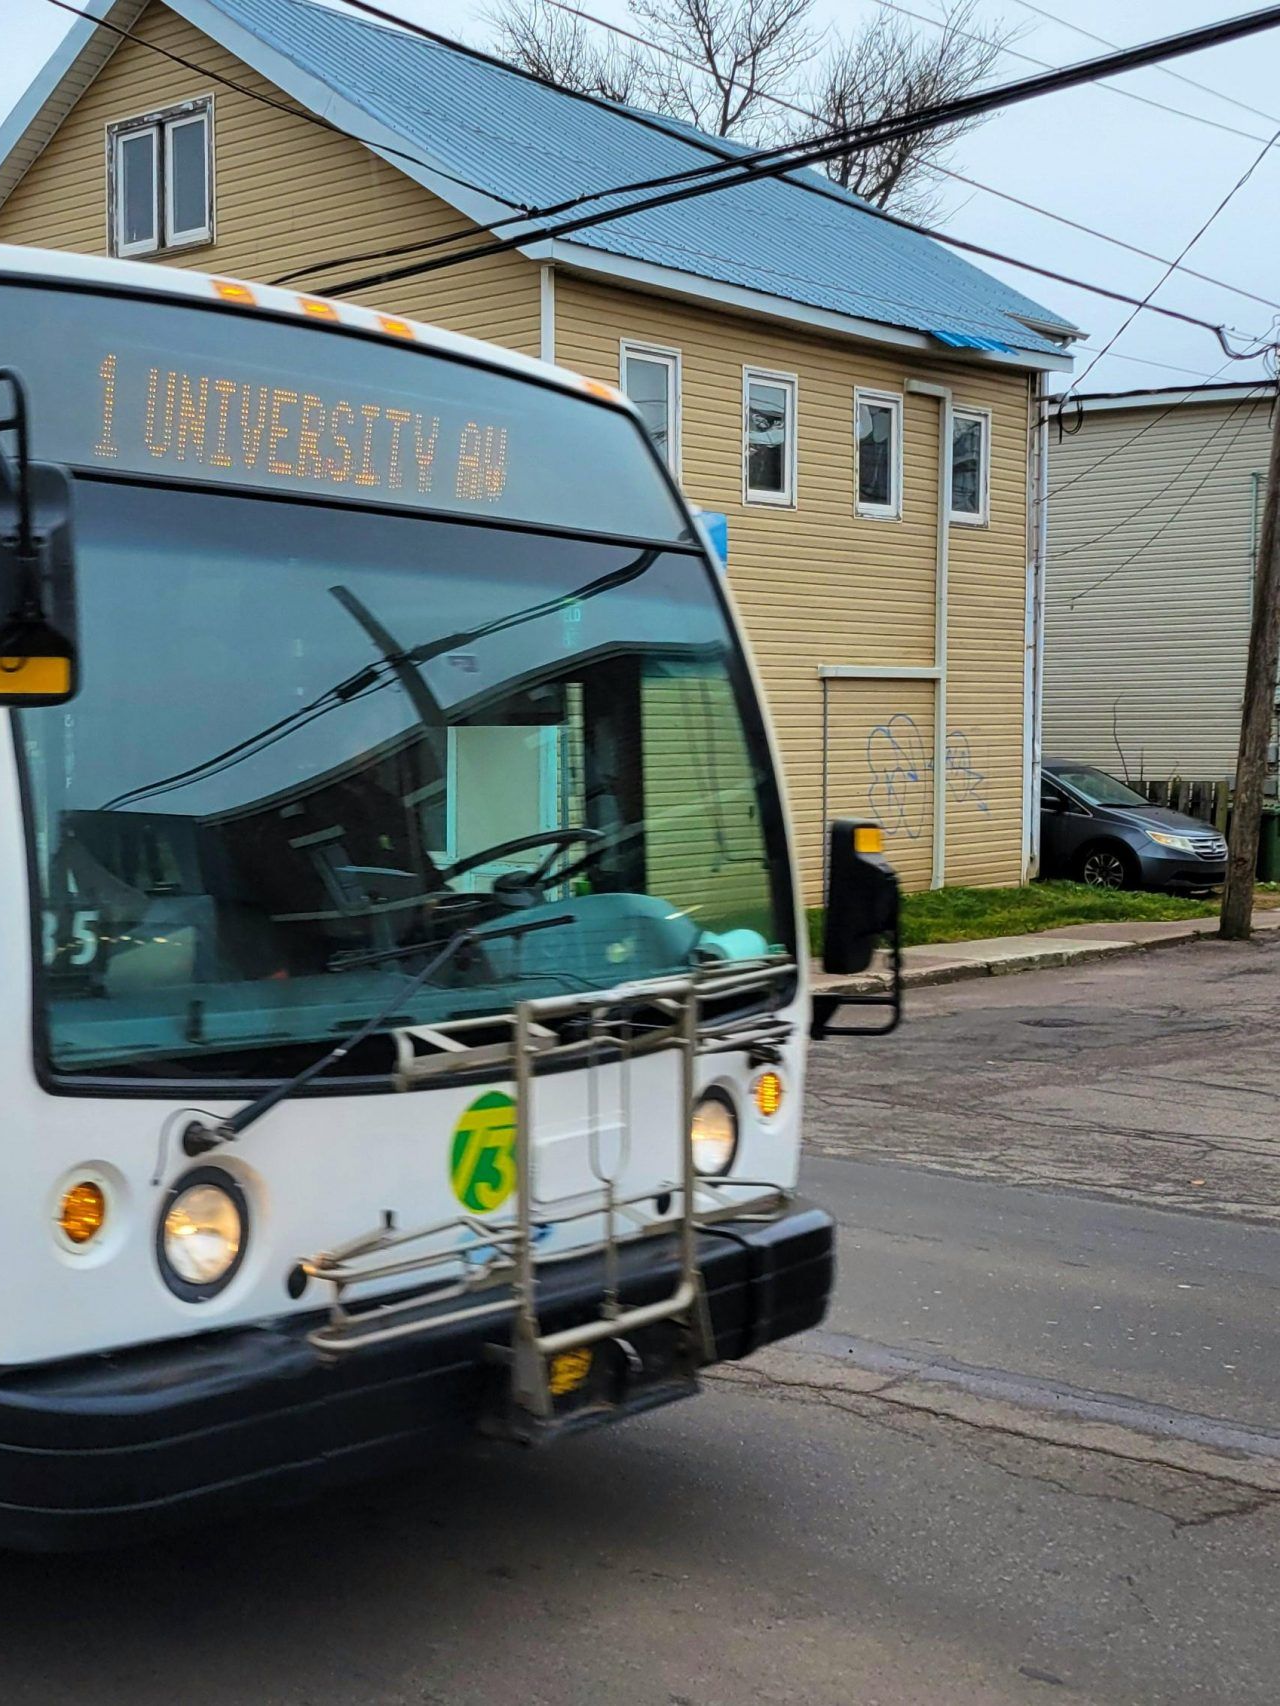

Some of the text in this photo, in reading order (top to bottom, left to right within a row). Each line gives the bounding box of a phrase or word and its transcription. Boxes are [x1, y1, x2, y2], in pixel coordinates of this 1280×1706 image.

[93, 353, 119, 459] 1
[144, 367, 442, 495] UNIVERSITY
[451, 1105, 517, 1211] T3
